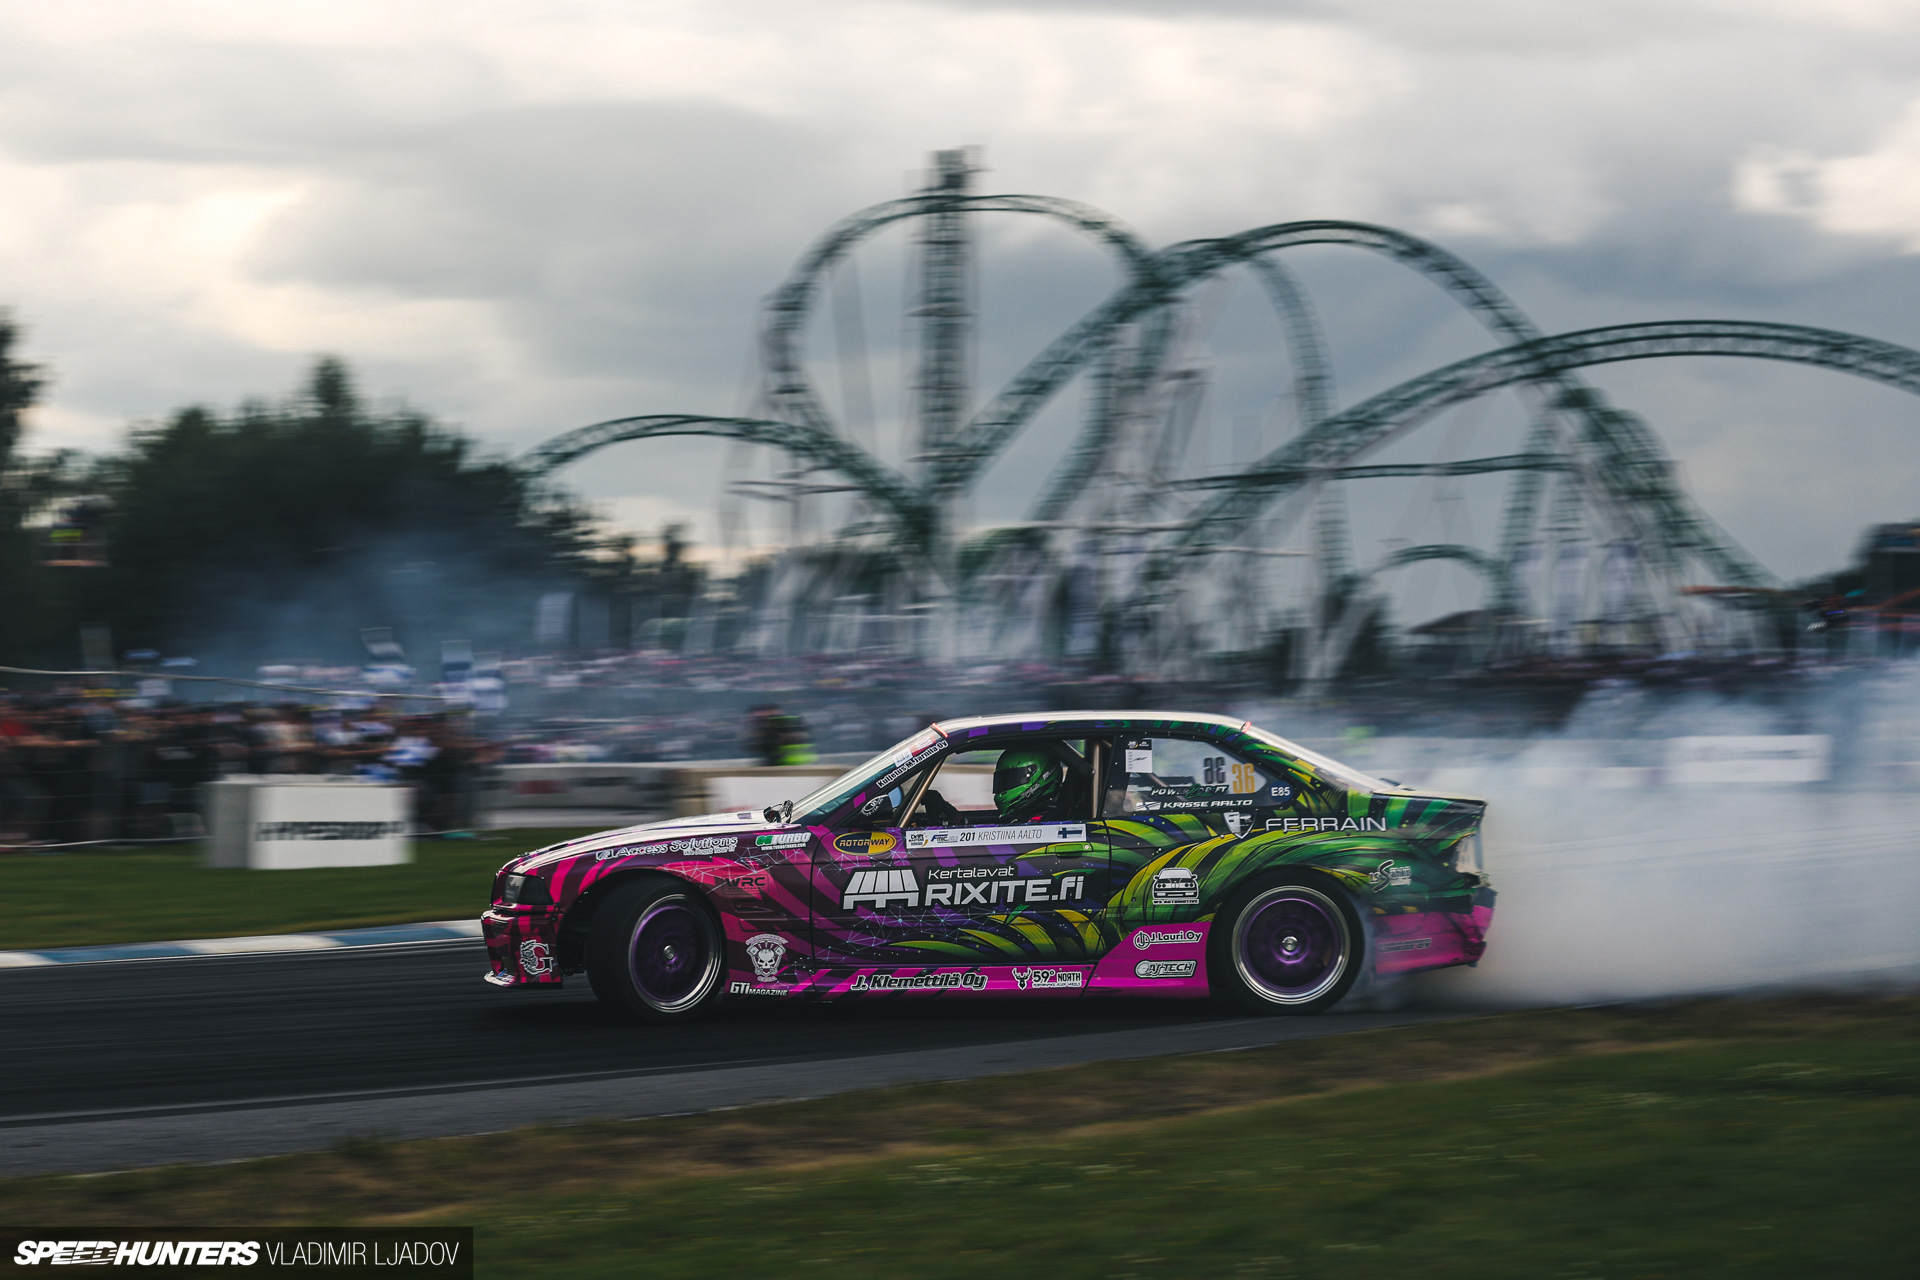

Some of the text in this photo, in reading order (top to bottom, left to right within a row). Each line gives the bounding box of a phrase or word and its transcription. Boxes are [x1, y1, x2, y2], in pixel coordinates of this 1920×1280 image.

[1231, 763, 1256, 794] 36
[1270, 786, 1291, 796] E85
[1163, 799, 1253, 809] KRISSE AALTO
[1265, 817, 1387, 832] FERRAIN
[960, 832, 976, 841] 201
[978, 830, 1016, 840] KRISTIINA
[1018, 829, 1043, 839] AALTO
[616, 836, 738, 858] Access Solutions
[839, 838, 890, 847] ROTORWAY
[928, 866, 1014, 879] Kertalavat
[725, 877, 766, 887] WRC
[925, 876, 1084, 906] RIXITE.fi
[1186, 930, 1202, 942] Oy
[851, 973, 988, 991] J. Klemettilä Oy
[1057, 972, 1082, 982] NORTH
[730, 981, 788, 996] GTi MAGAZINE
